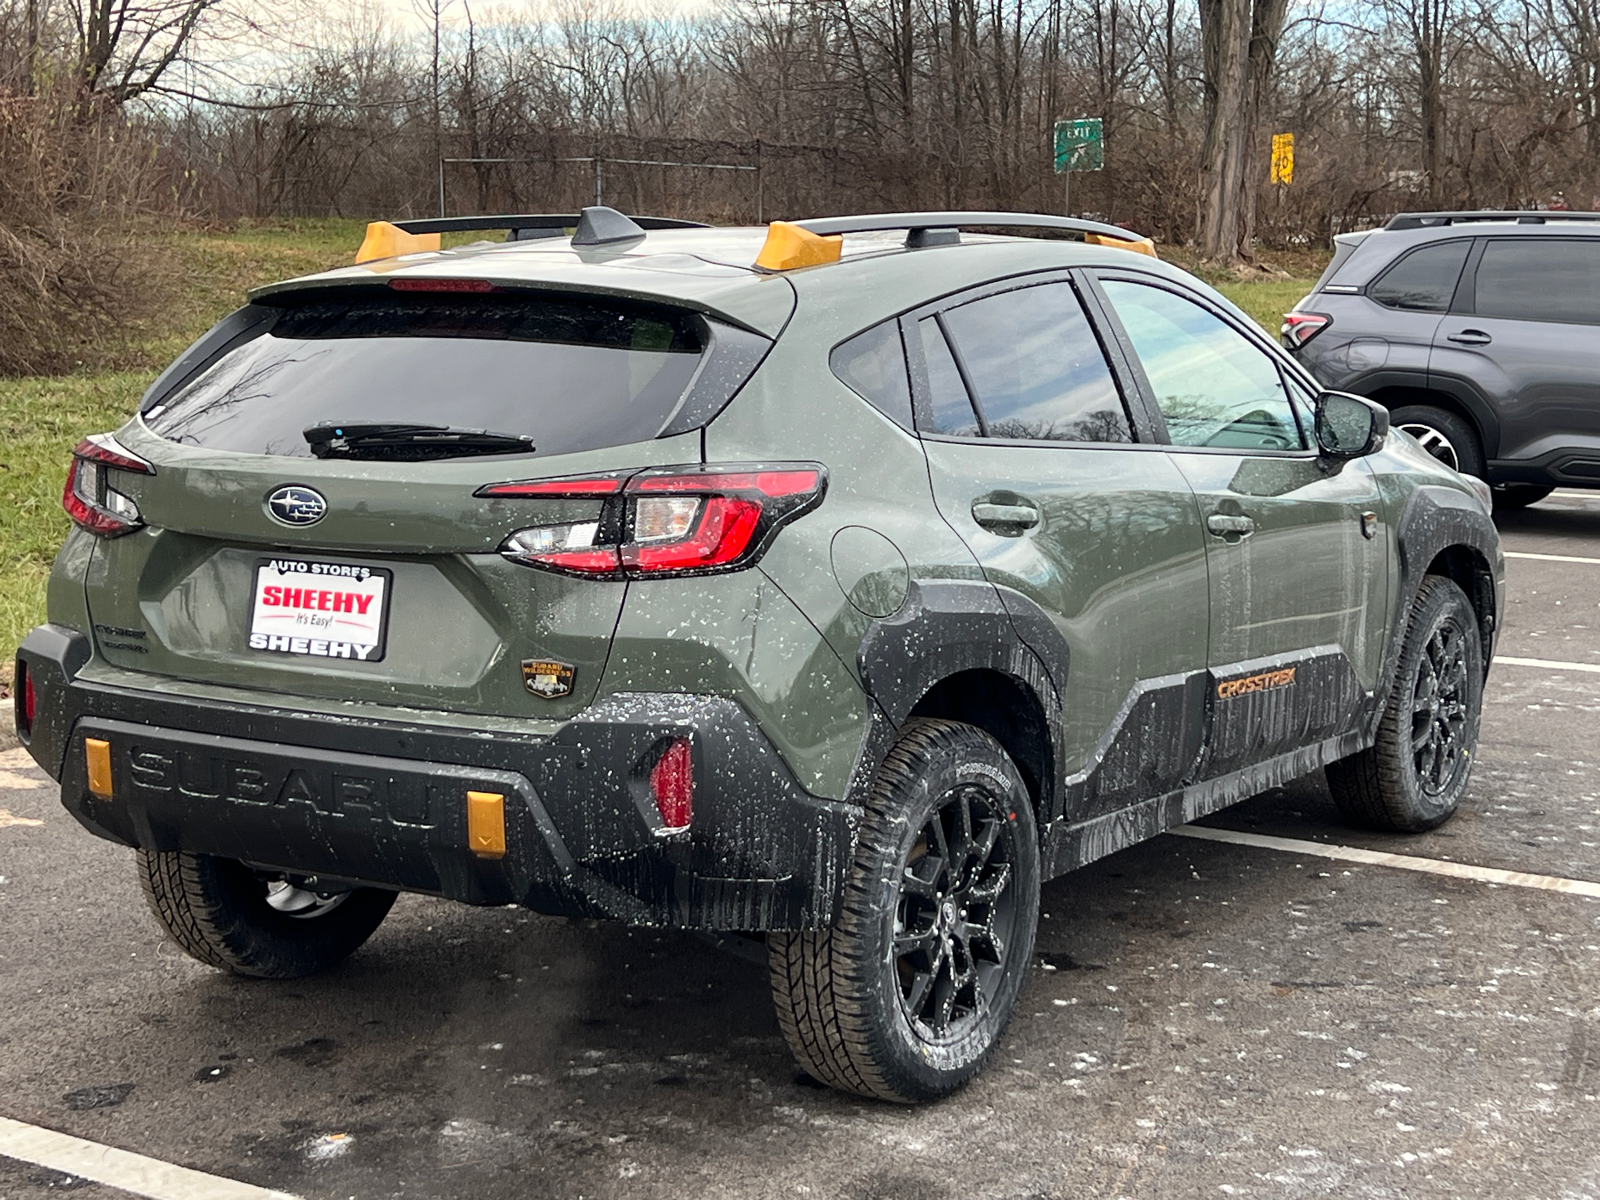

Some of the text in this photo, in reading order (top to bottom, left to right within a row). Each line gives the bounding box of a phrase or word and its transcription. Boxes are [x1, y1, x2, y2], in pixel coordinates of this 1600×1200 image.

[1066, 127, 1091, 139] EXIT
[268, 560, 371, 578] AUTO STORES
[262, 585, 375, 615] SHEEHY
[296, 613, 334, 630] It's Easy!
[249, 633, 377, 660] SHEEHY
[1217, 667, 1297, 699] CROSSTREK
[129, 745, 439, 829] SUBARU
